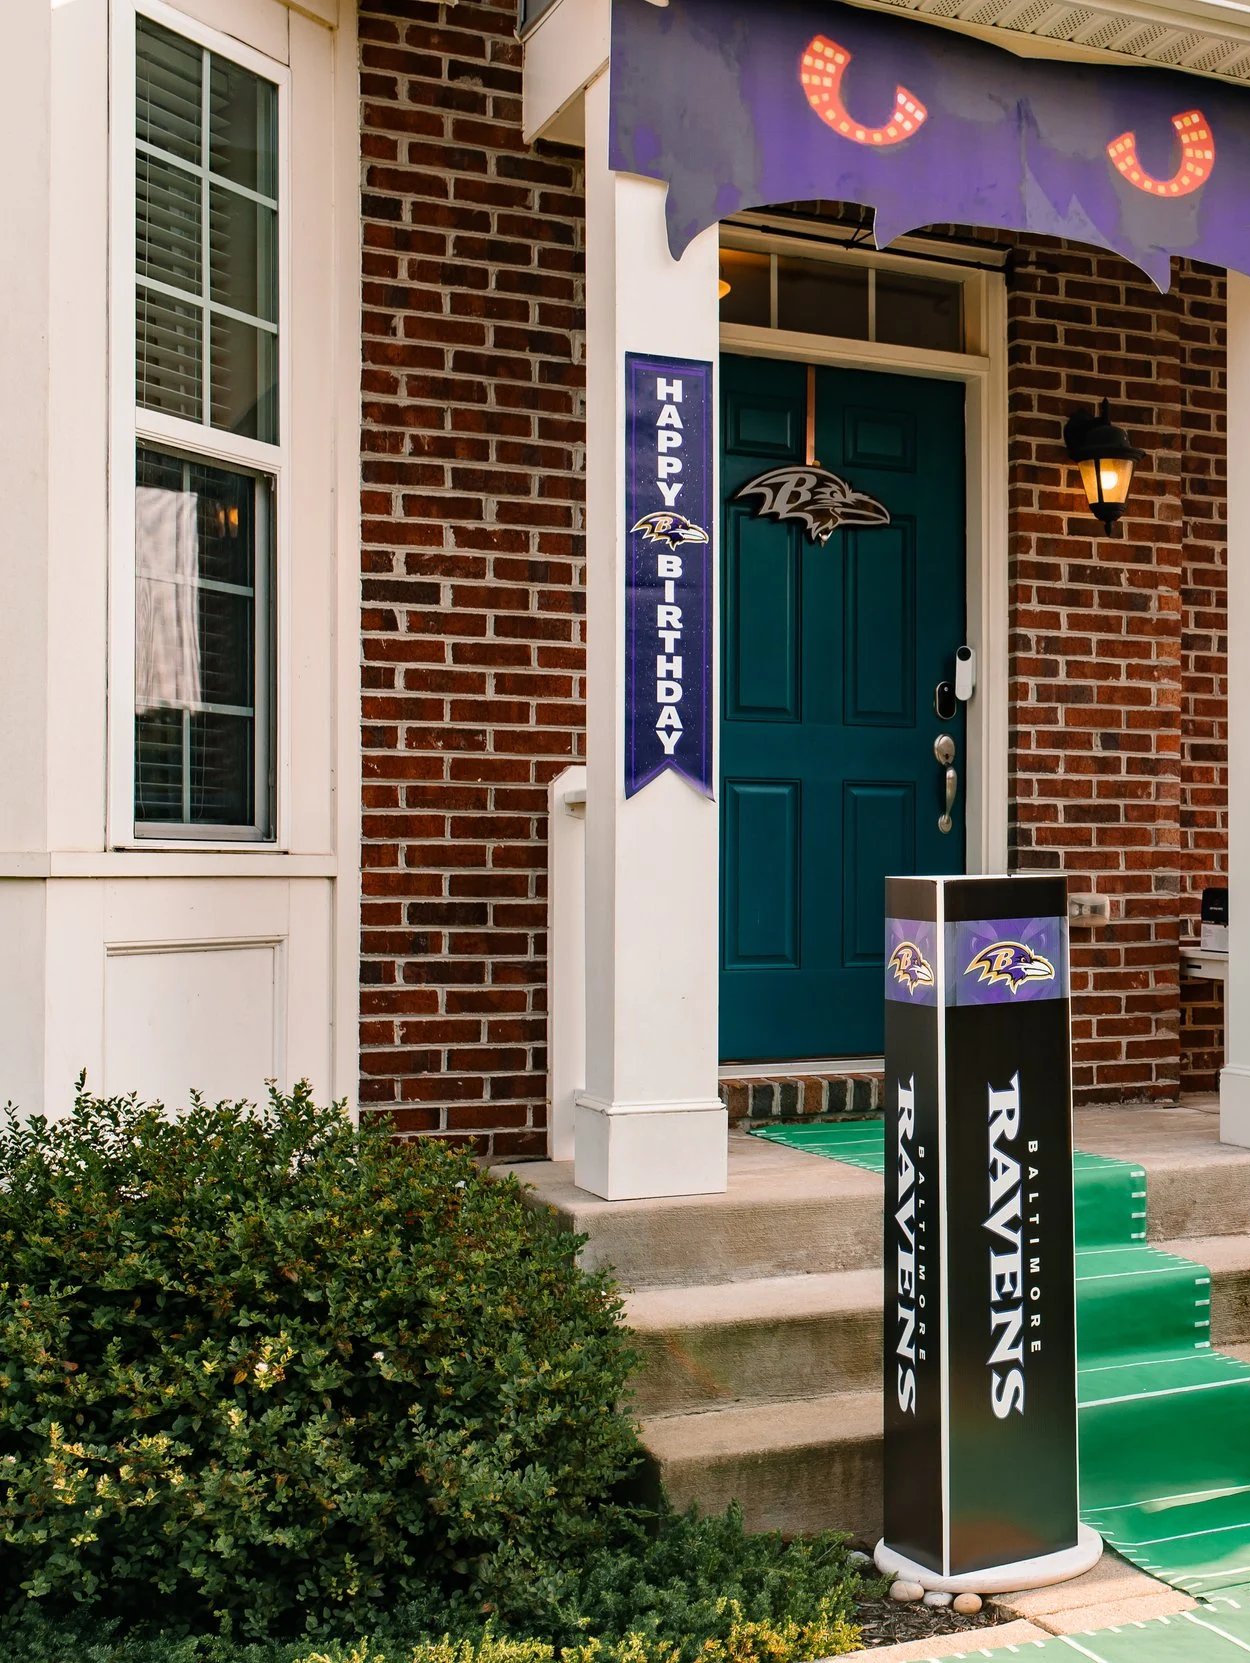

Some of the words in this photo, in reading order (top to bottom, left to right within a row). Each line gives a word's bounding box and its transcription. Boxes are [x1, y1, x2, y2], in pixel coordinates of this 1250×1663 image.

[656, 377, 683, 507] HAPPY
[655, 554, 683, 755] BIRTHDAY
[893, 1073, 917, 1416] RAVENS
[917, 1145, 927, 1362] BALTIMORE
[980, 1070, 1026, 1420] RAVENS
[1027, 1140, 1042, 1354] BALTIMORE
